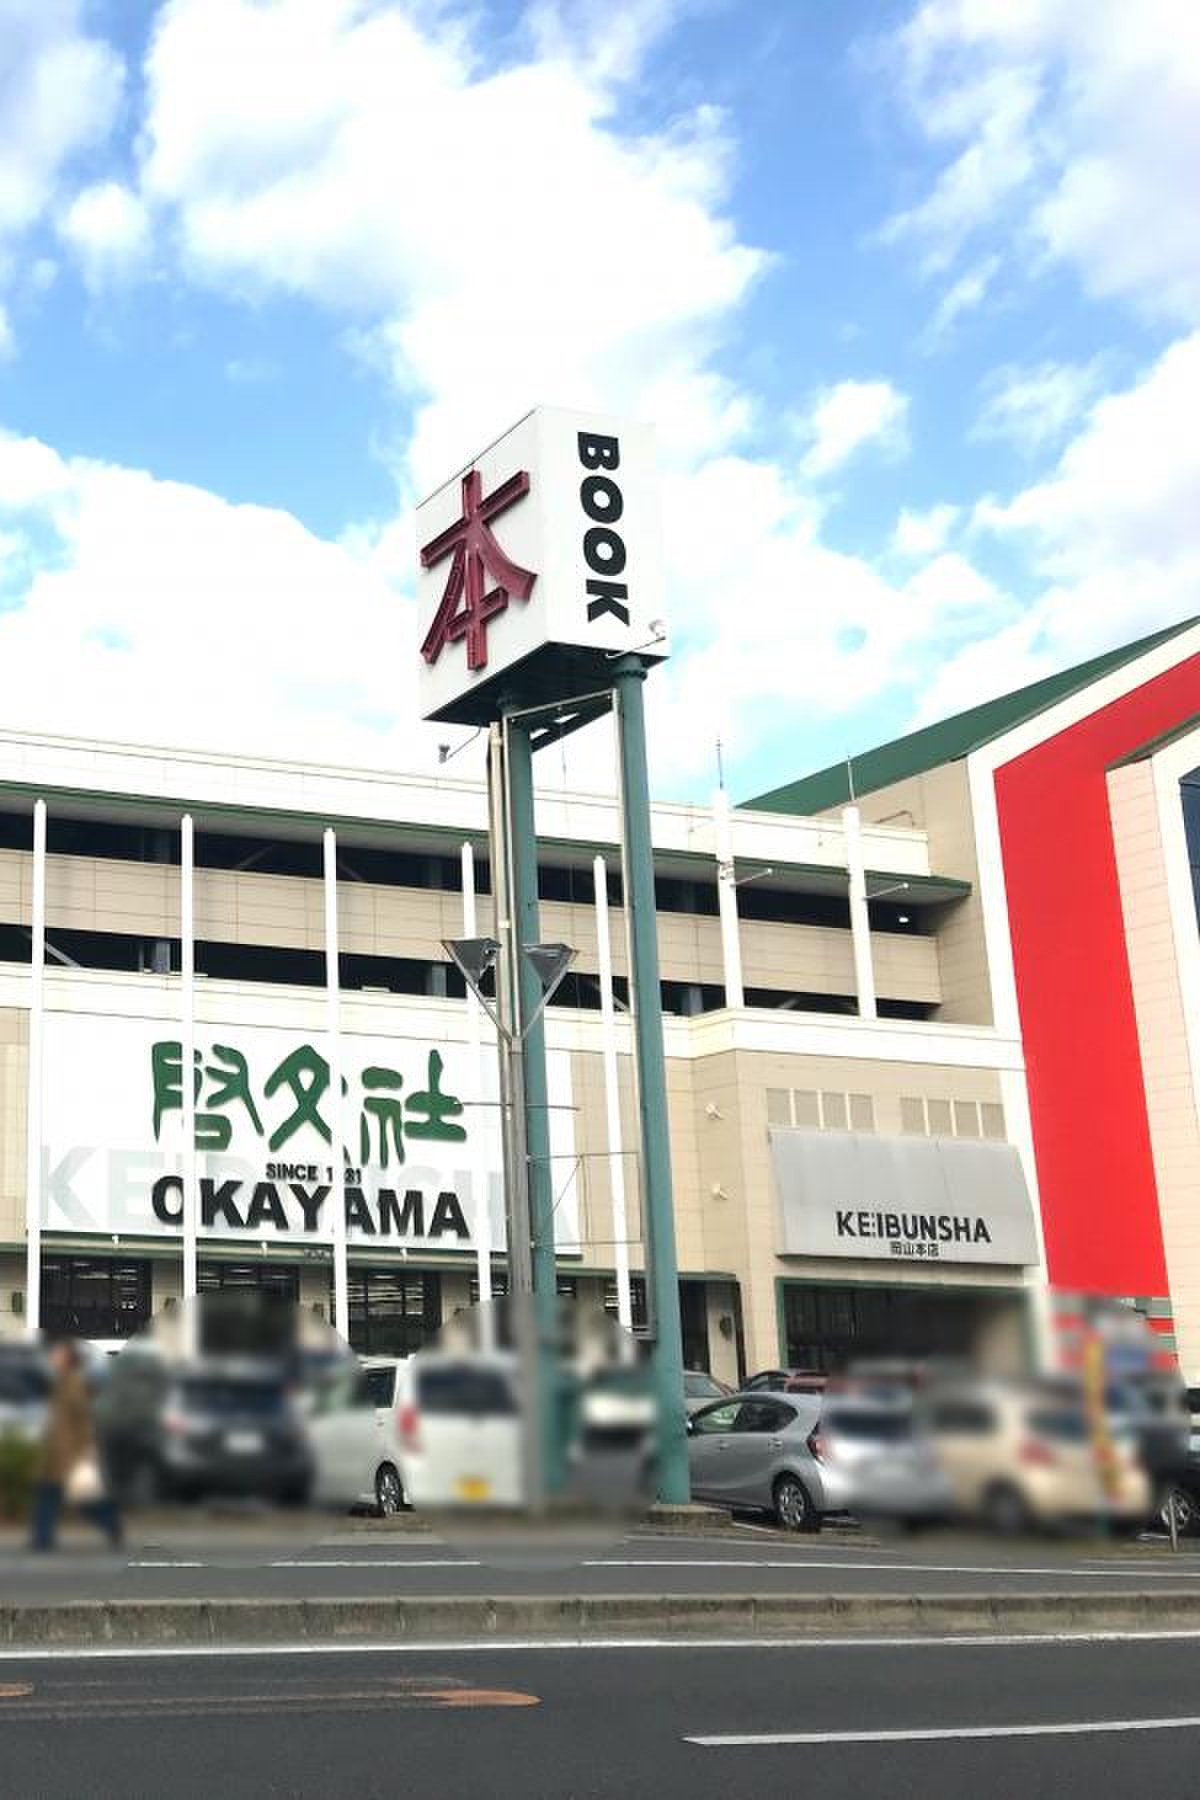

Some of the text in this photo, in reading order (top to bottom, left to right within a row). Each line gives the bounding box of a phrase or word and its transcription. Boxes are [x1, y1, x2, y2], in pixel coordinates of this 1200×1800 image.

[420, 469, 538, 670] 本
[577, 431, 630, 627] BOOK
[151, 1041, 467, 1169] 啓文社
[152, 1175, 471, 1240] OKAYAMA
[266, 1162, 363, 1185] SINCE 181
[836, 1211, 992, 1243] KEIBUNSHA
